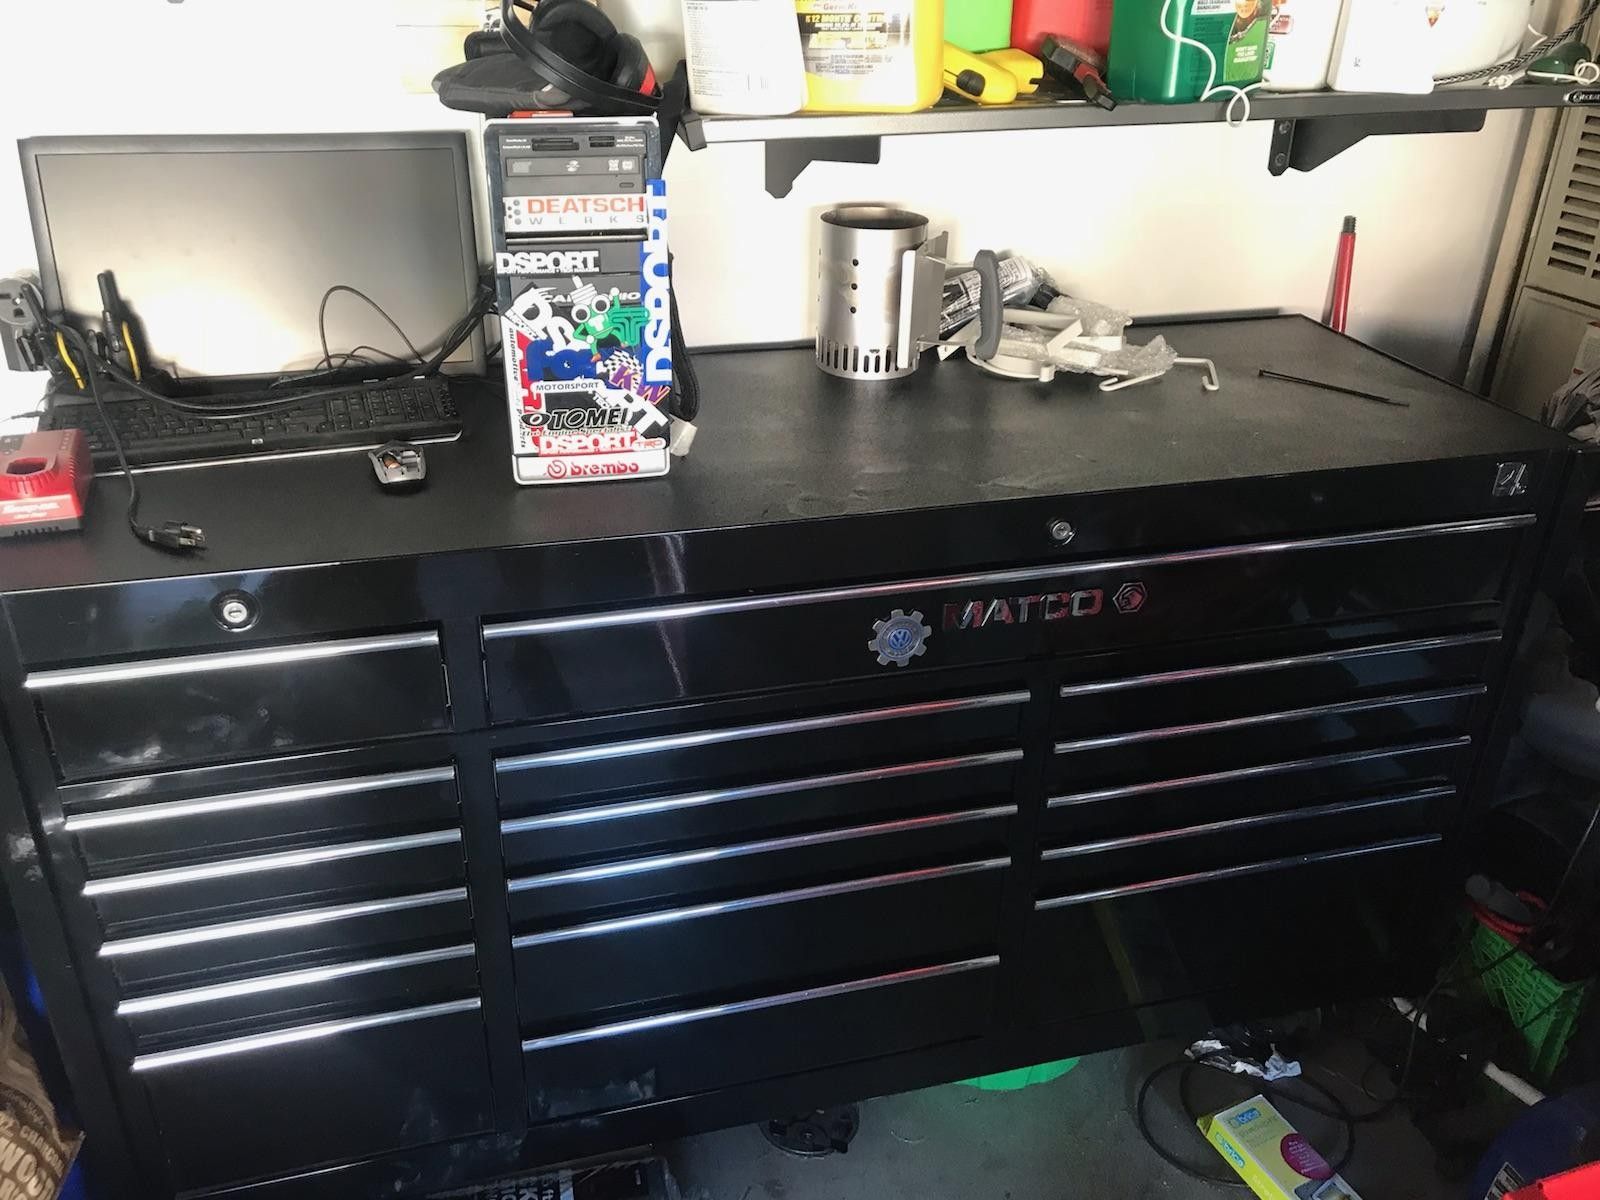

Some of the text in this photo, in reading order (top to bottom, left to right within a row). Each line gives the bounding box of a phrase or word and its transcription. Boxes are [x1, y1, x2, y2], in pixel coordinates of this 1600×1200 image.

[527, 196, 644, 214] DEATSCH
[496, 250, 599, 274] DSPORT
[643, 184, 672, 382] DSPORT
[509, 327, 519, 382] automotive
[536, 382, 600, 391] MOTORSPORT
[550, 407, 629, 430] TOMEI
[540, 431, 635, 452] DSPORT
[571, 460, 640, 476] brembo
[942, 589, 1104, 630] MATCO
[20, 1125, 65, 1178] CHARCOAL
